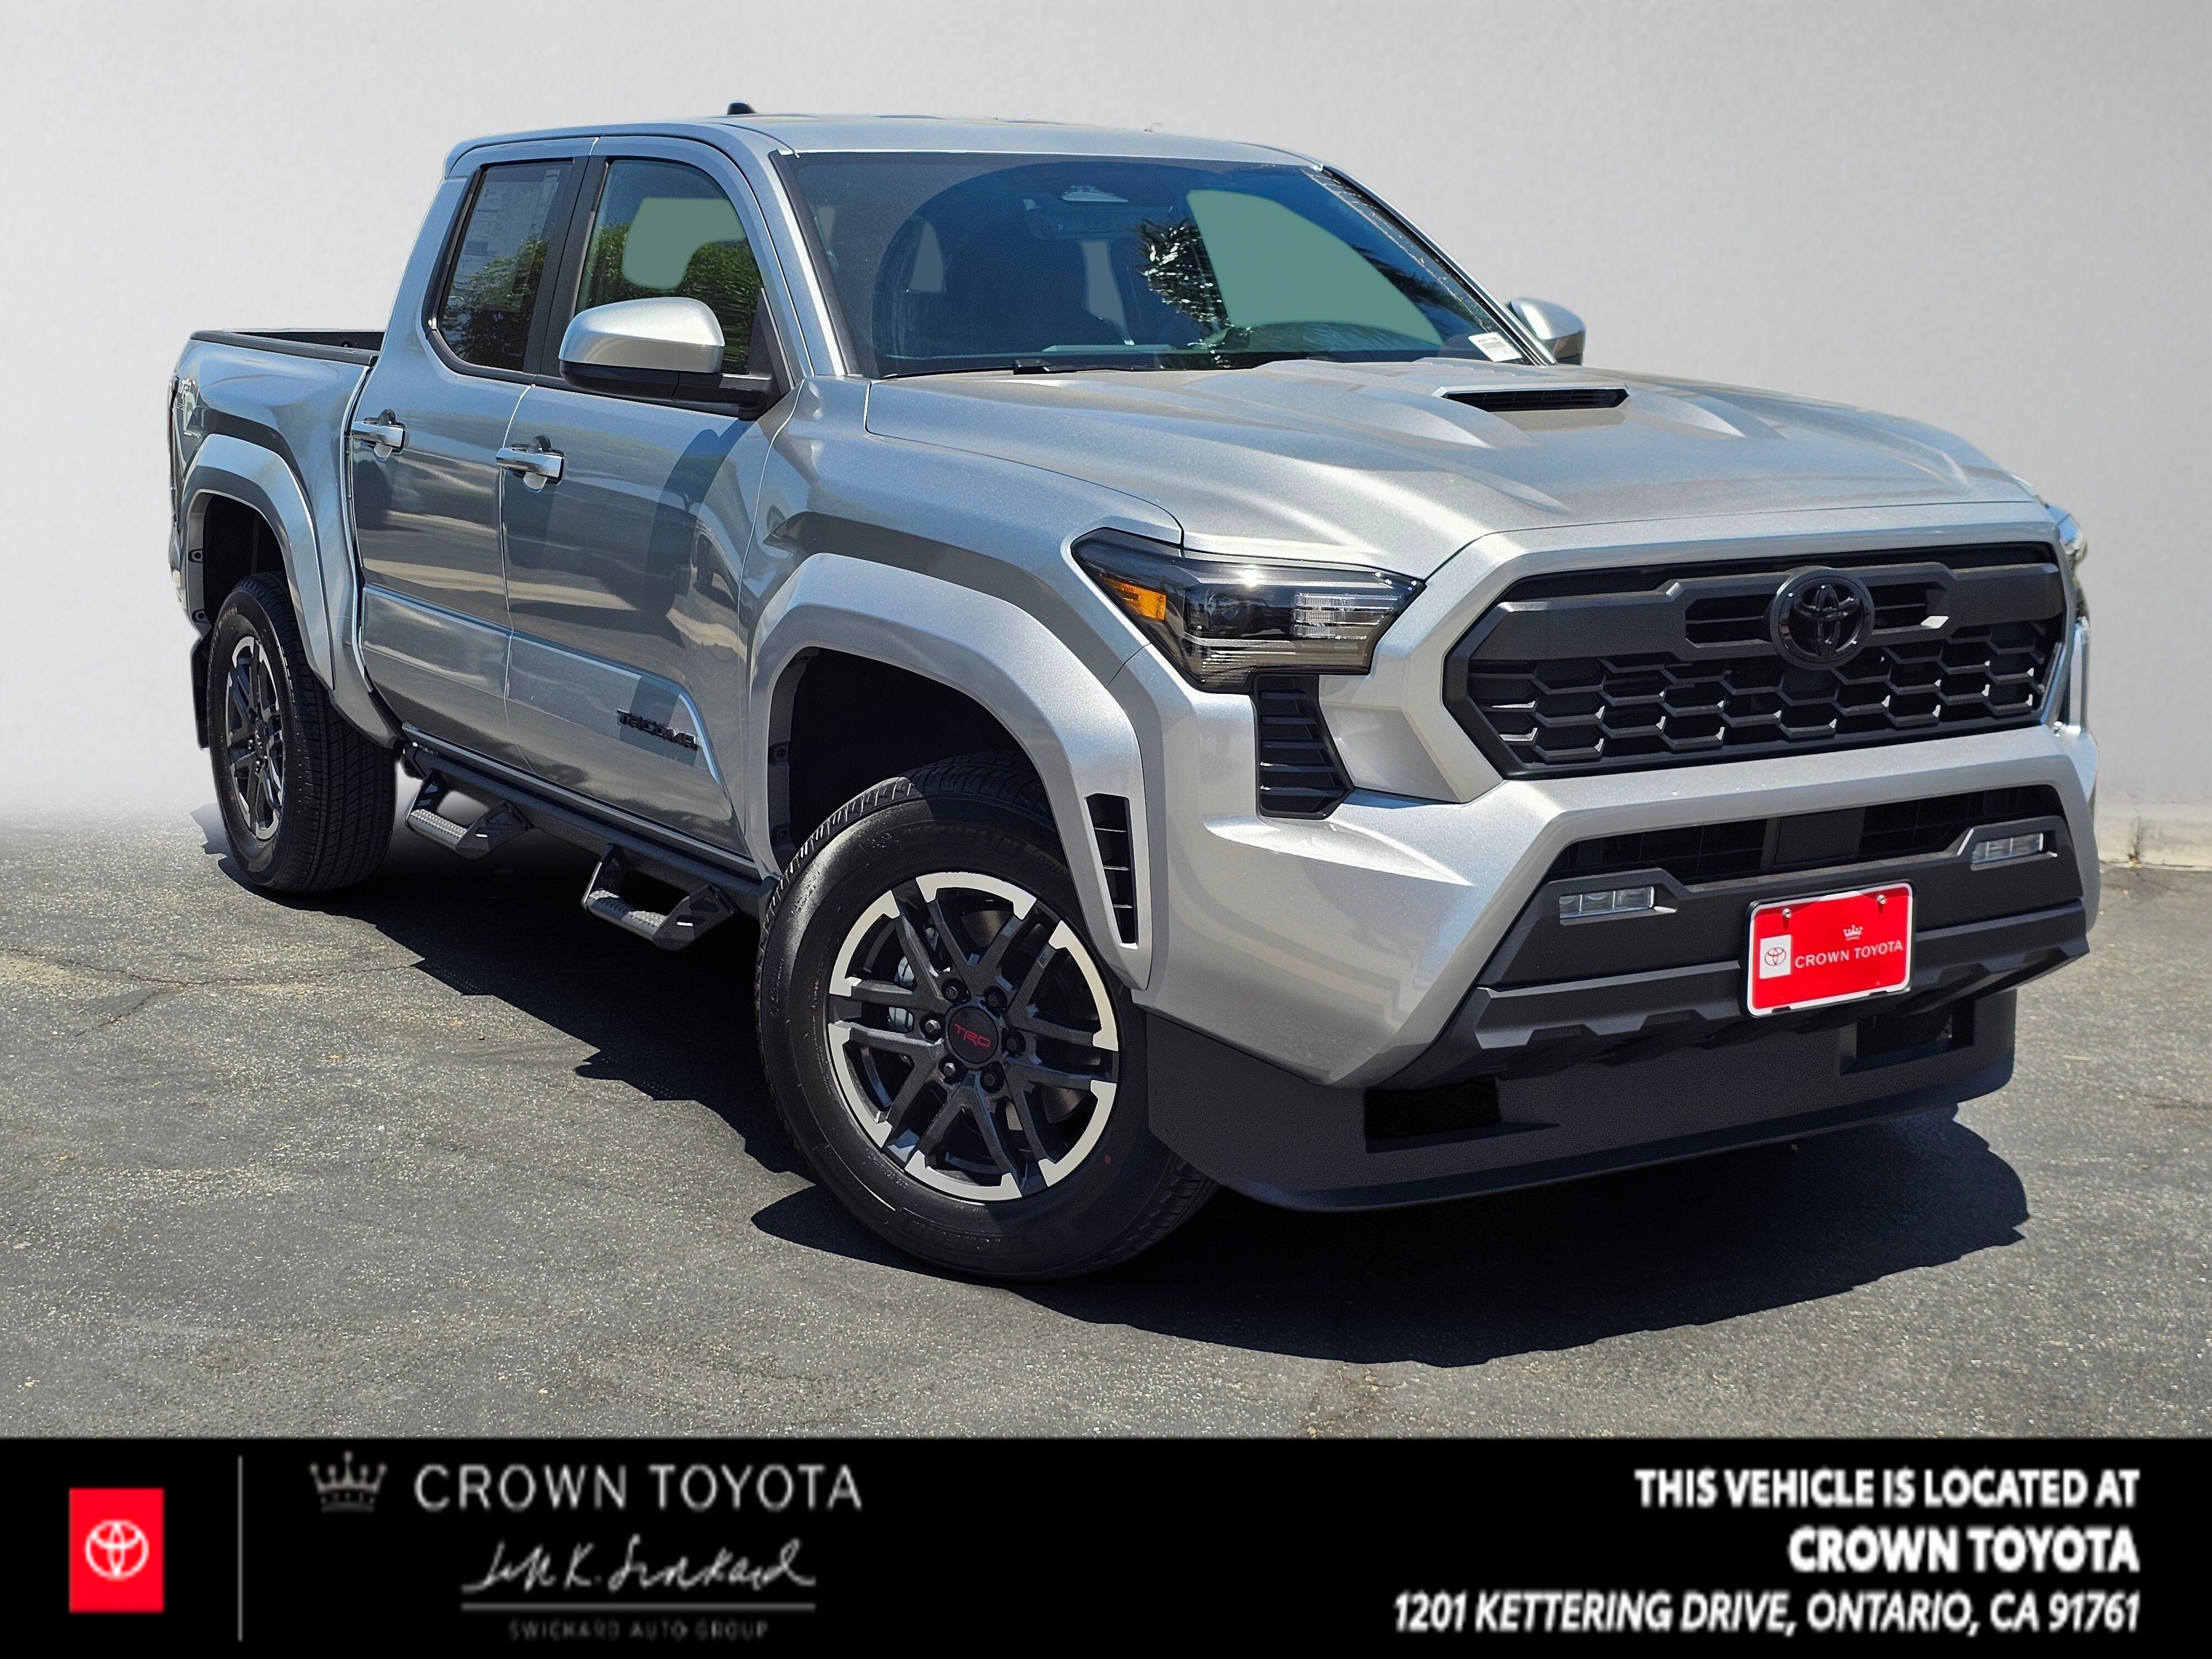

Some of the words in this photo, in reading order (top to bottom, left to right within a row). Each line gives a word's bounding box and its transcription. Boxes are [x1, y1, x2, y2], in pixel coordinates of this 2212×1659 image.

[1794, 948, 1849, 969] CROWN
[1855, 940, 1903, 959] TOYOTA
[954, 1023, 991, 1048] TRD
